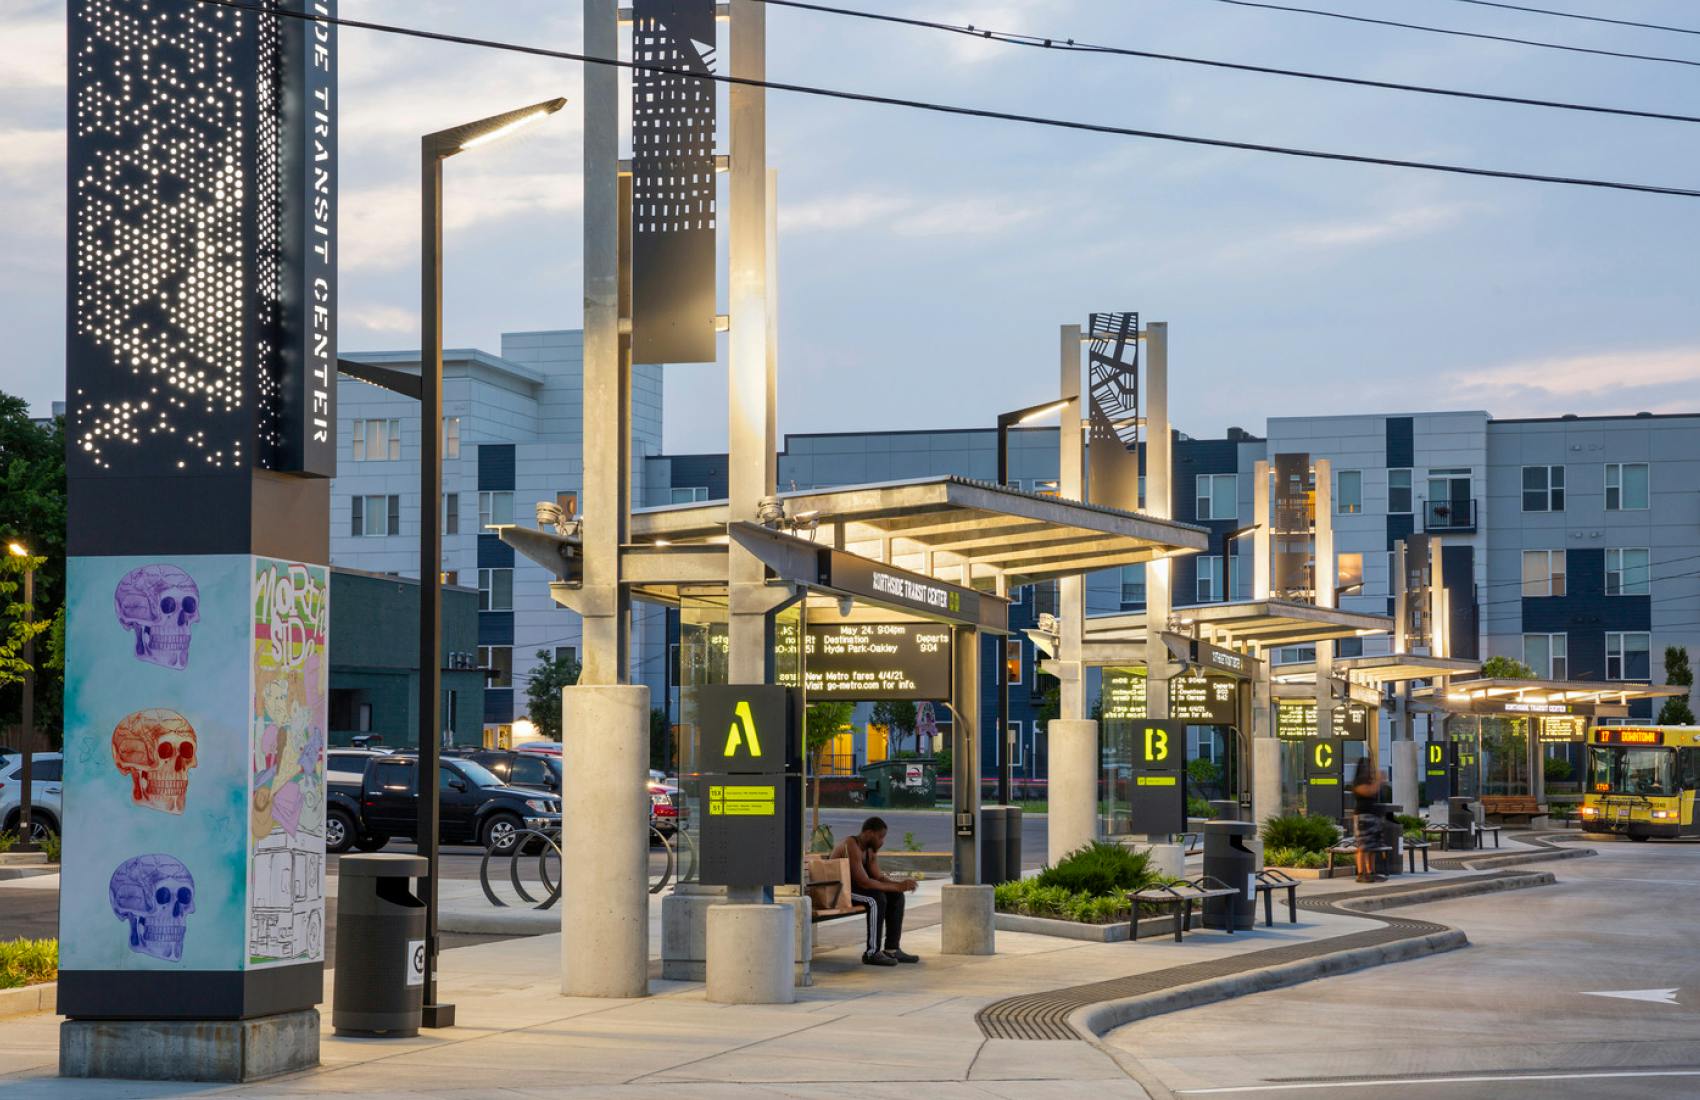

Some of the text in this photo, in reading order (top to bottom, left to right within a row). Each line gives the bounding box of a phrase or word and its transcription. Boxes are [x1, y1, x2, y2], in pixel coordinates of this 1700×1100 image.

[313, 0, 329, 443] IDE TRANSIT CENTER
[904, 579, 927, 603] TRANSIT
[927, 586, 948, 609] CENTER
[840, 625, 857, 636] May
[823, 634, 869, 645] Destination
[916, 633, 949, 645] Departs
[823, 644, 845, 655] Hyde
[805, 672, 823, 681] New
[825, 671, 849, 681] Metro
[852, 671, 875, 681] fares
[805, 681, 823, 691] Visit
[883, 680, 896, 690] for
[724, 701, 762, 757] A
[1144, 728, 1168, 761] B
[1601, 731, 1655, 743] 17 DOWNTOWN
[1315, 744, 1332, 768] C
[1430, 745, 1442, 763] D
